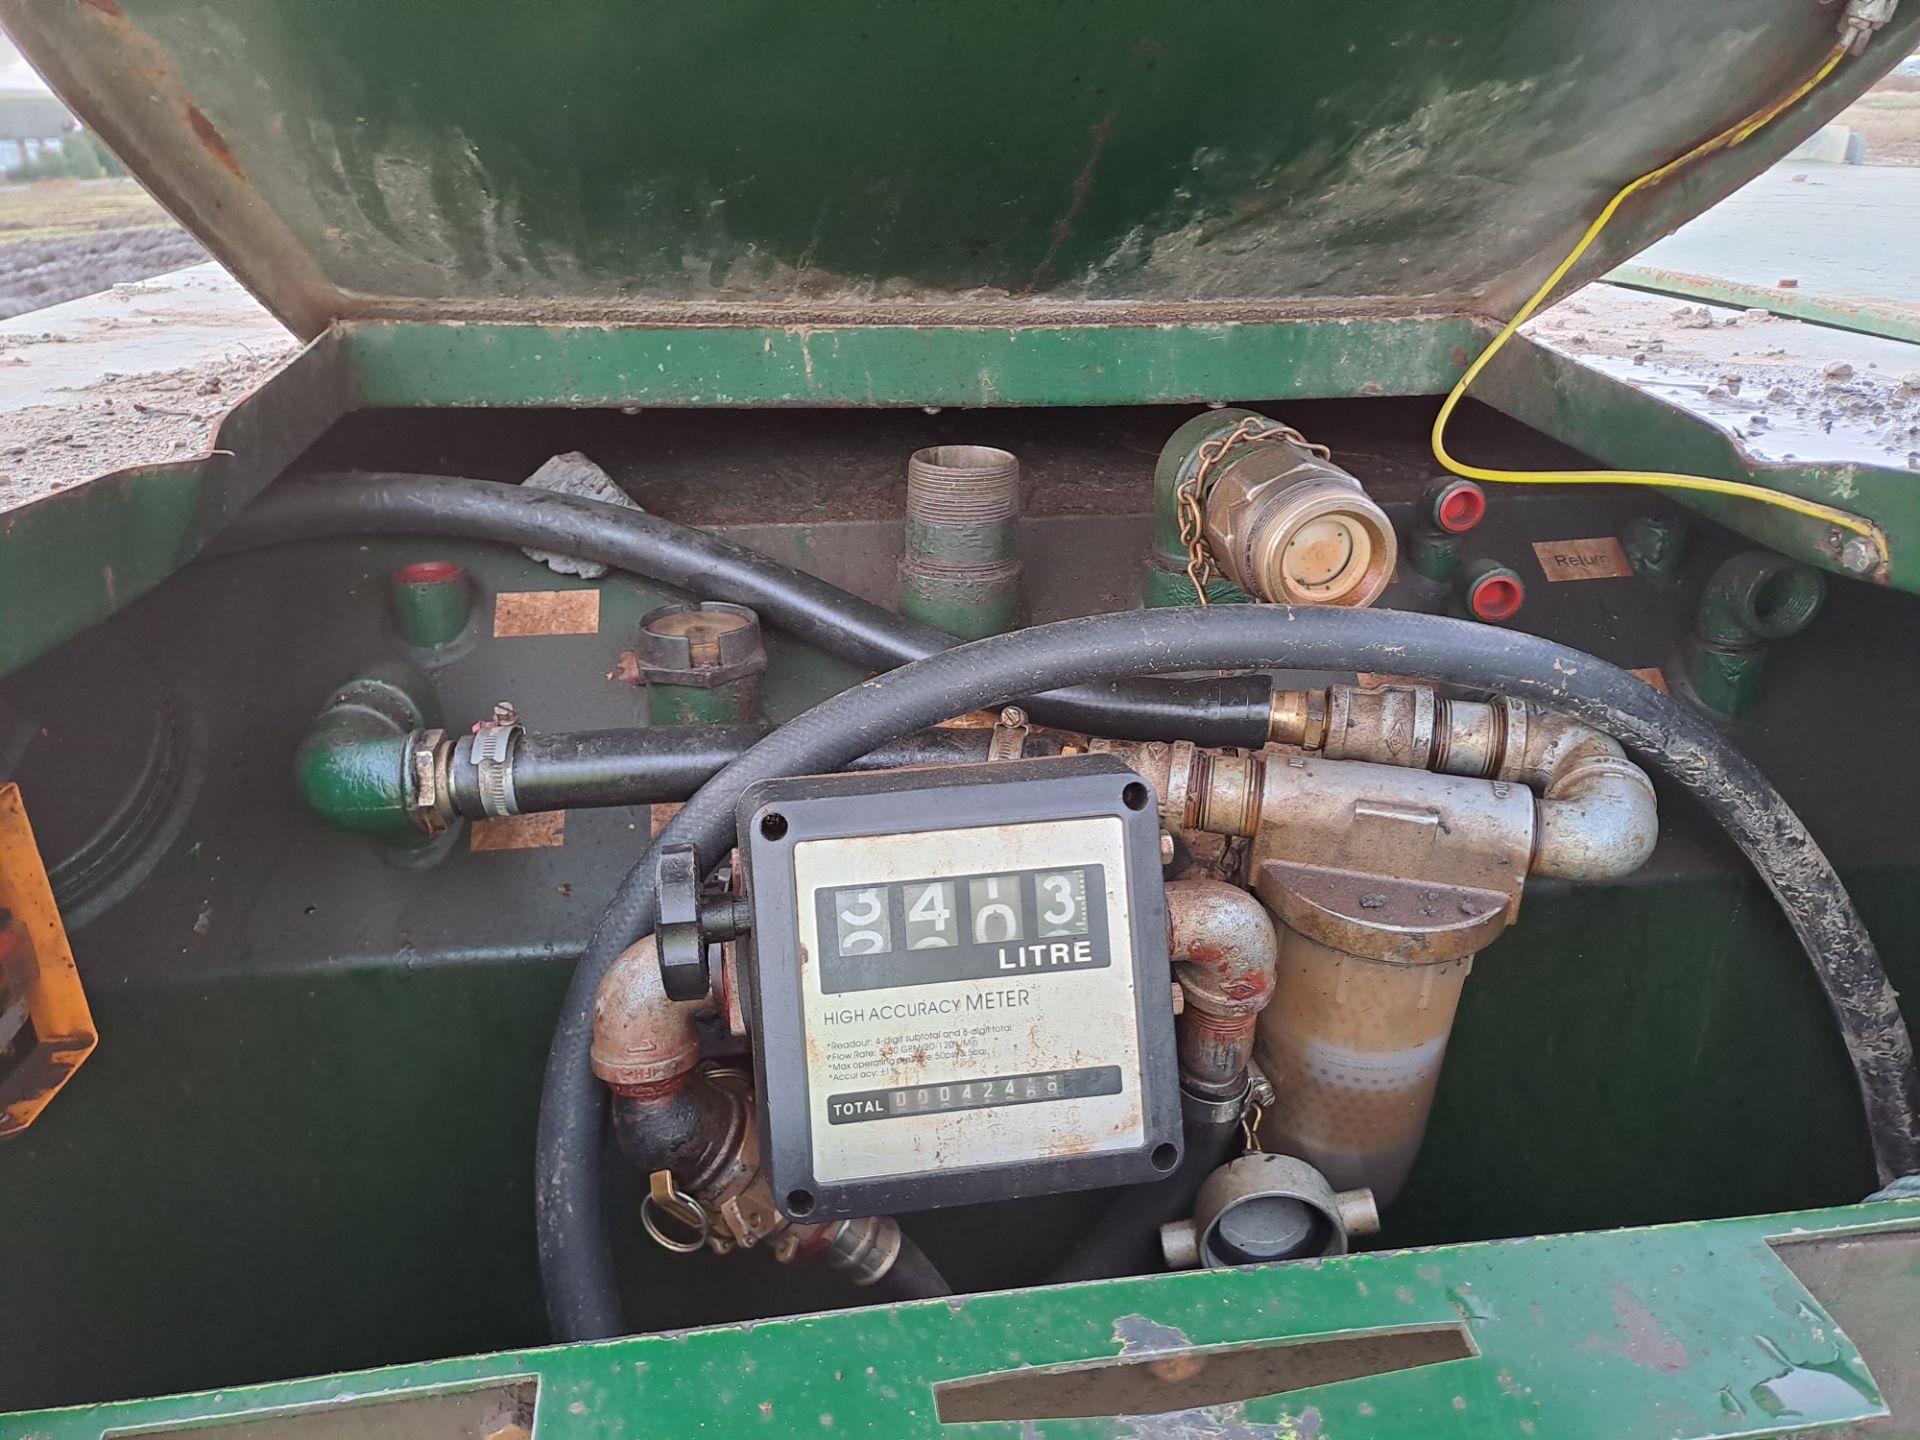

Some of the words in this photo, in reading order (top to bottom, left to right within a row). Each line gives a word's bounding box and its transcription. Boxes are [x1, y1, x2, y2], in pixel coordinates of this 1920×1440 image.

[999, 940, 1093, 970] LITRE
[823, 1009, 865, 1026] HIGH
[868, 999, 961, 1021] ACCURACY
[966, 988, 1030, 1012] METER
[904, 1031, 941, 1042] subtotal
[943, 1029, 961, 1038] and
[852, 1057, 896, 1070] operating
[833, 1099, 884, 1117] TOTAL
